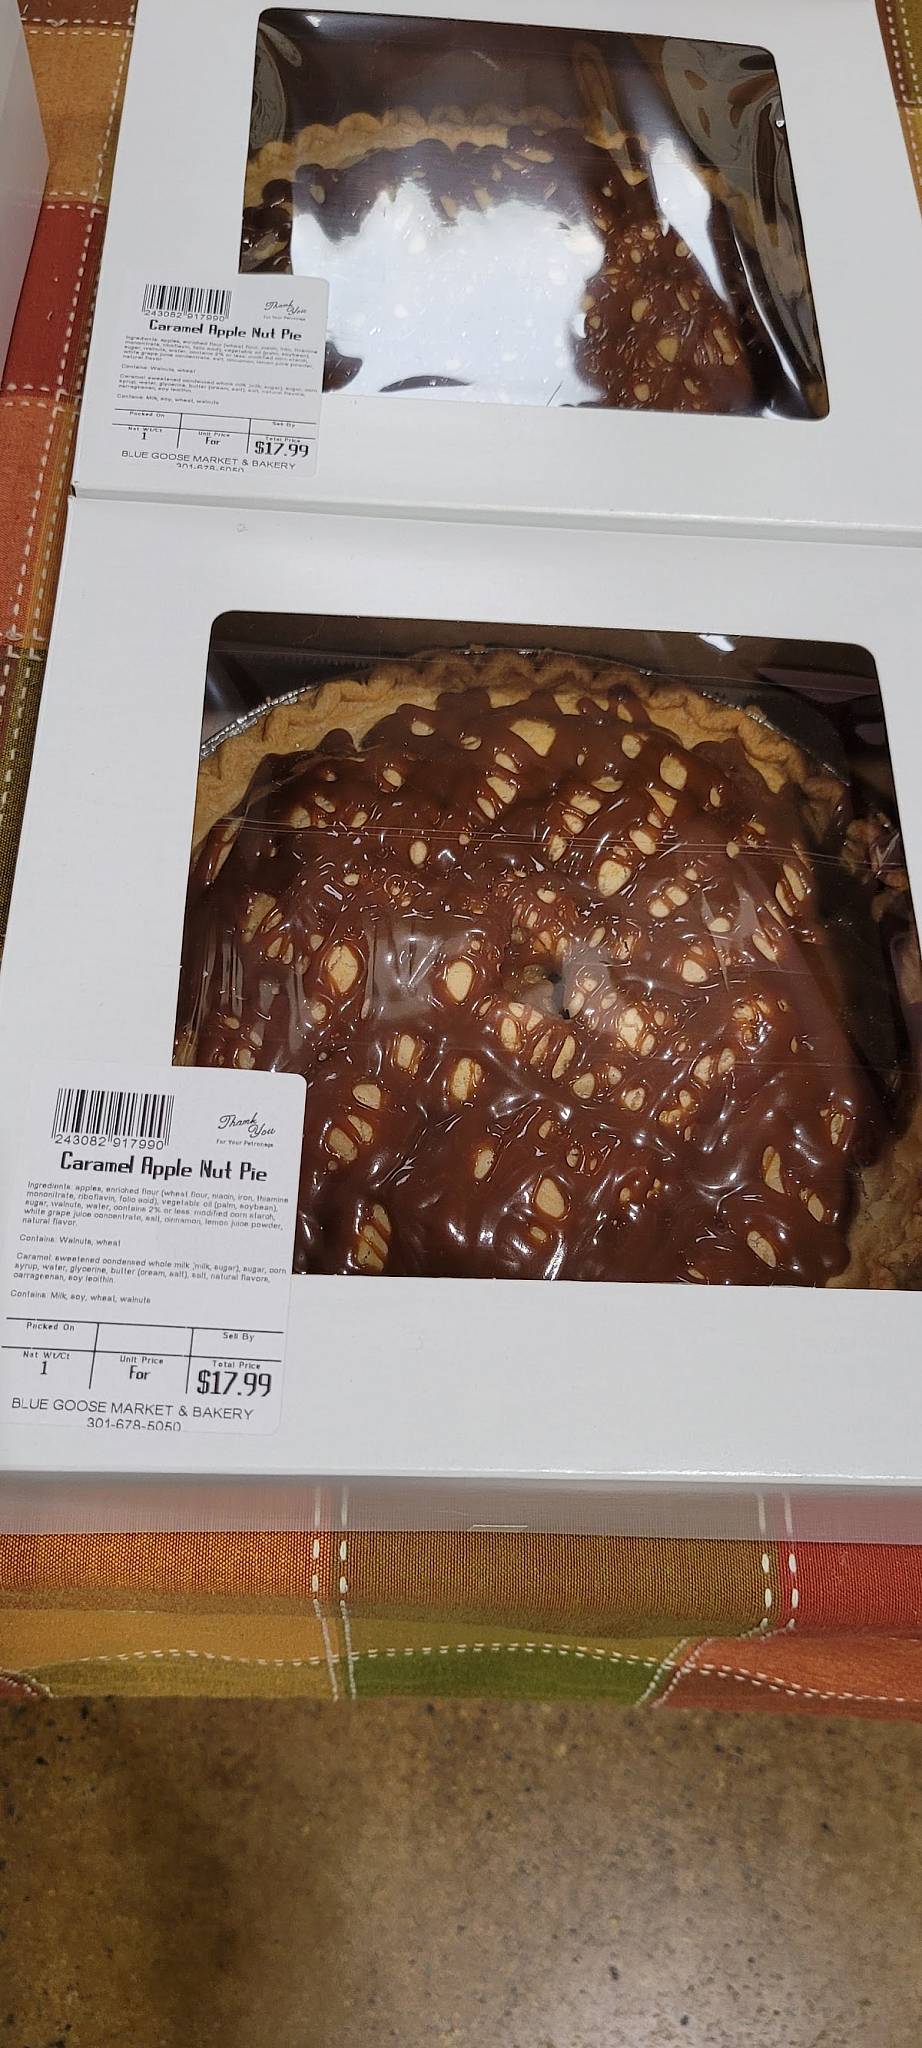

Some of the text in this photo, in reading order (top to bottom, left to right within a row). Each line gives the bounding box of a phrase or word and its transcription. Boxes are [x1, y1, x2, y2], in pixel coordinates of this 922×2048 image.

[149, 319, 302, 341] Caramel Apple Nut Pie
[141, 432, 147, 440] 1
[205, 436, 221, 445] For
[254, 441, 309, 458] $17.99
[121, 450, 296, 470] BLUE GOOSE MARKET & BAKERY
[217, 1112, 258, 1129] Thank
[247, 1123, 276, 1138] You
[55, 1134, 164, 1150] 243082 917990
[60, 1151, 268, 1181] Caramel Apple Nut Pie
[63, 1323, 75, 1331] On
[242, 1332, 255, 1342] By
[43, 1351, 71, 1360] Wt/Ct
[120, 1355, 164, 1364] Unit Price
[40, 1360, 48, 1375] 1
[129, 1365, 151, 1380] For
[213, 1360, 261, 1370] Total Price
[196, 1369, 272, 1397] $17.99
[11, 1397, 255, 1420] BLUE GOOSE MARKET & BAKERY
[87, 1417, 182, 1432] 301-678-5050
